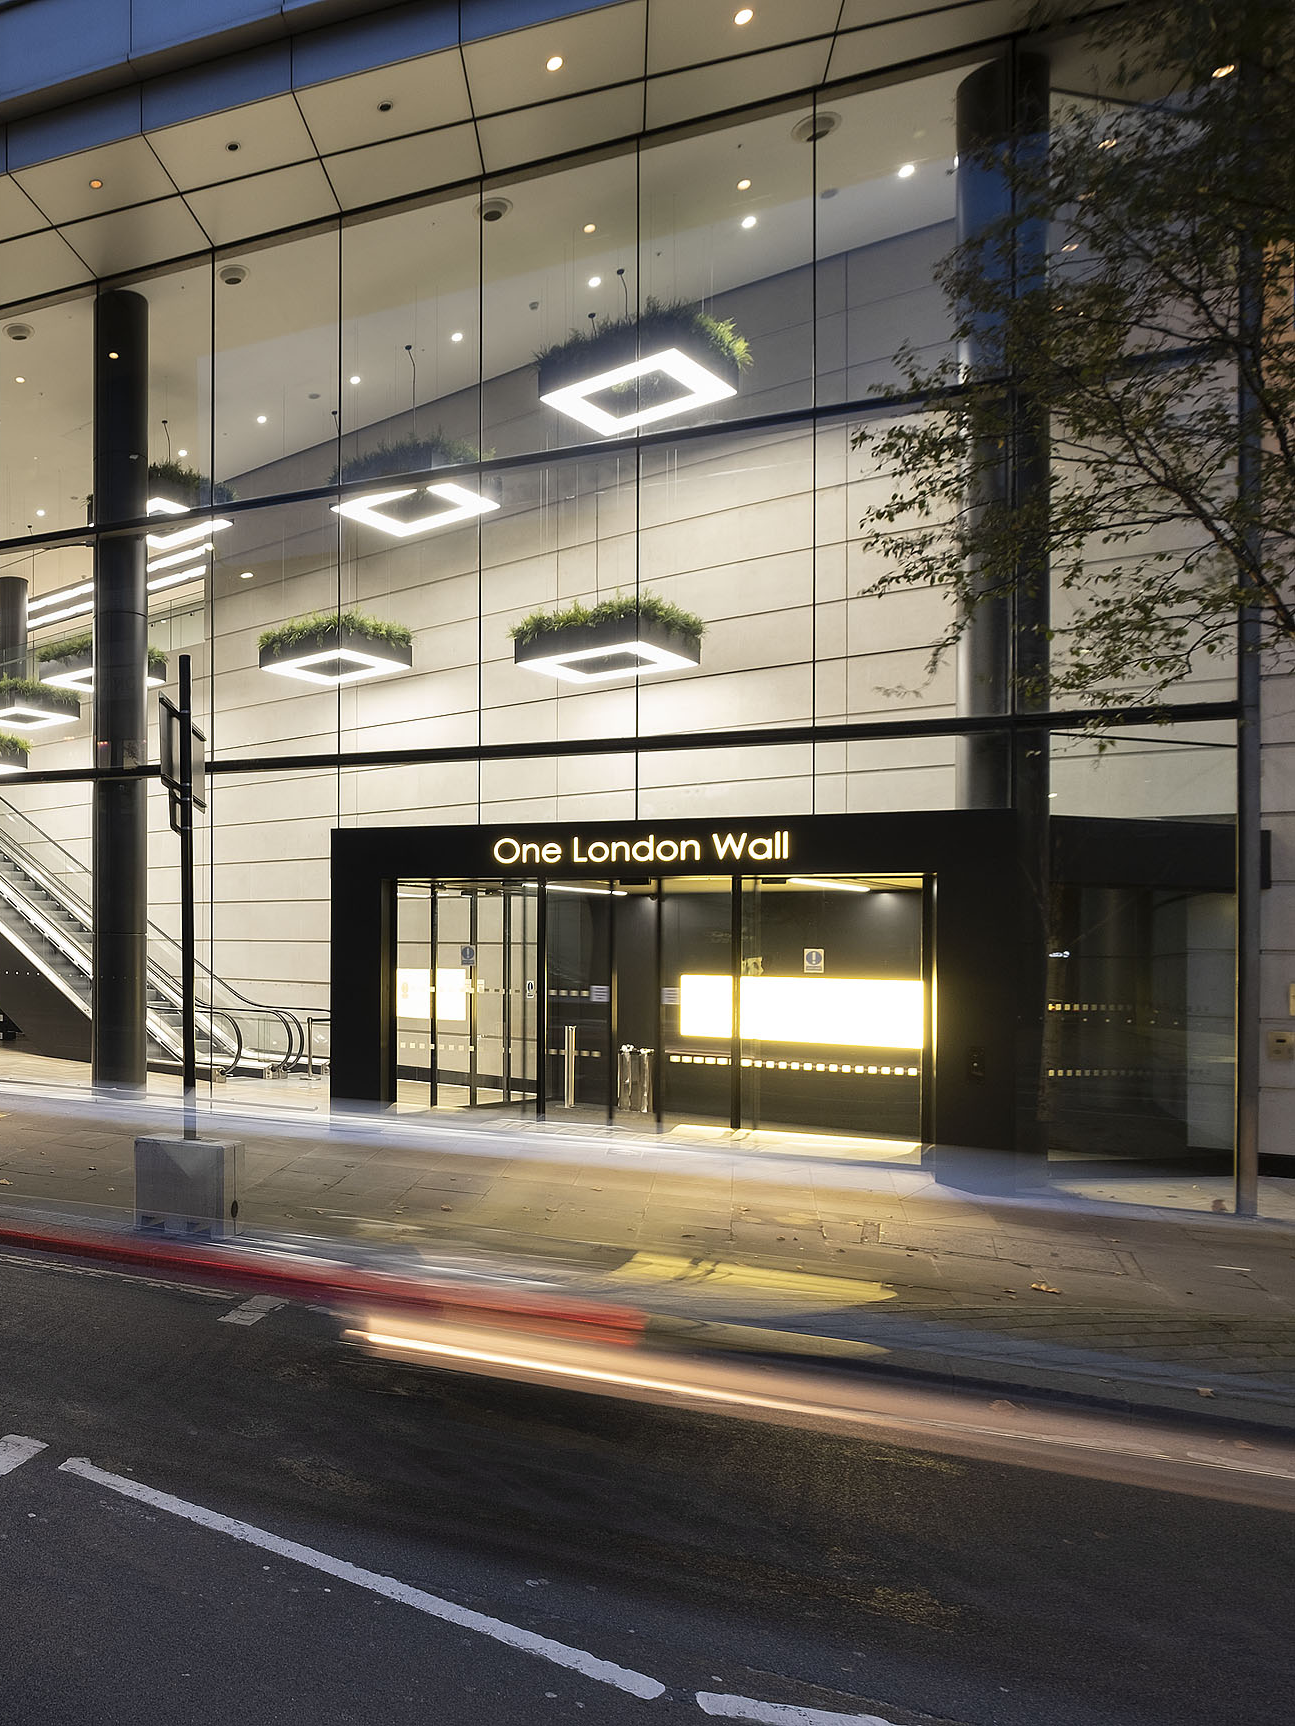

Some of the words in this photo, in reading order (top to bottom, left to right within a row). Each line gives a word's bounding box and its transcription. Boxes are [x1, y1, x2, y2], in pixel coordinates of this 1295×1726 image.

[493, 837, 562, 864] One
[573, 834, 701, 863] London
[711, 830, 790, 861] Wall
